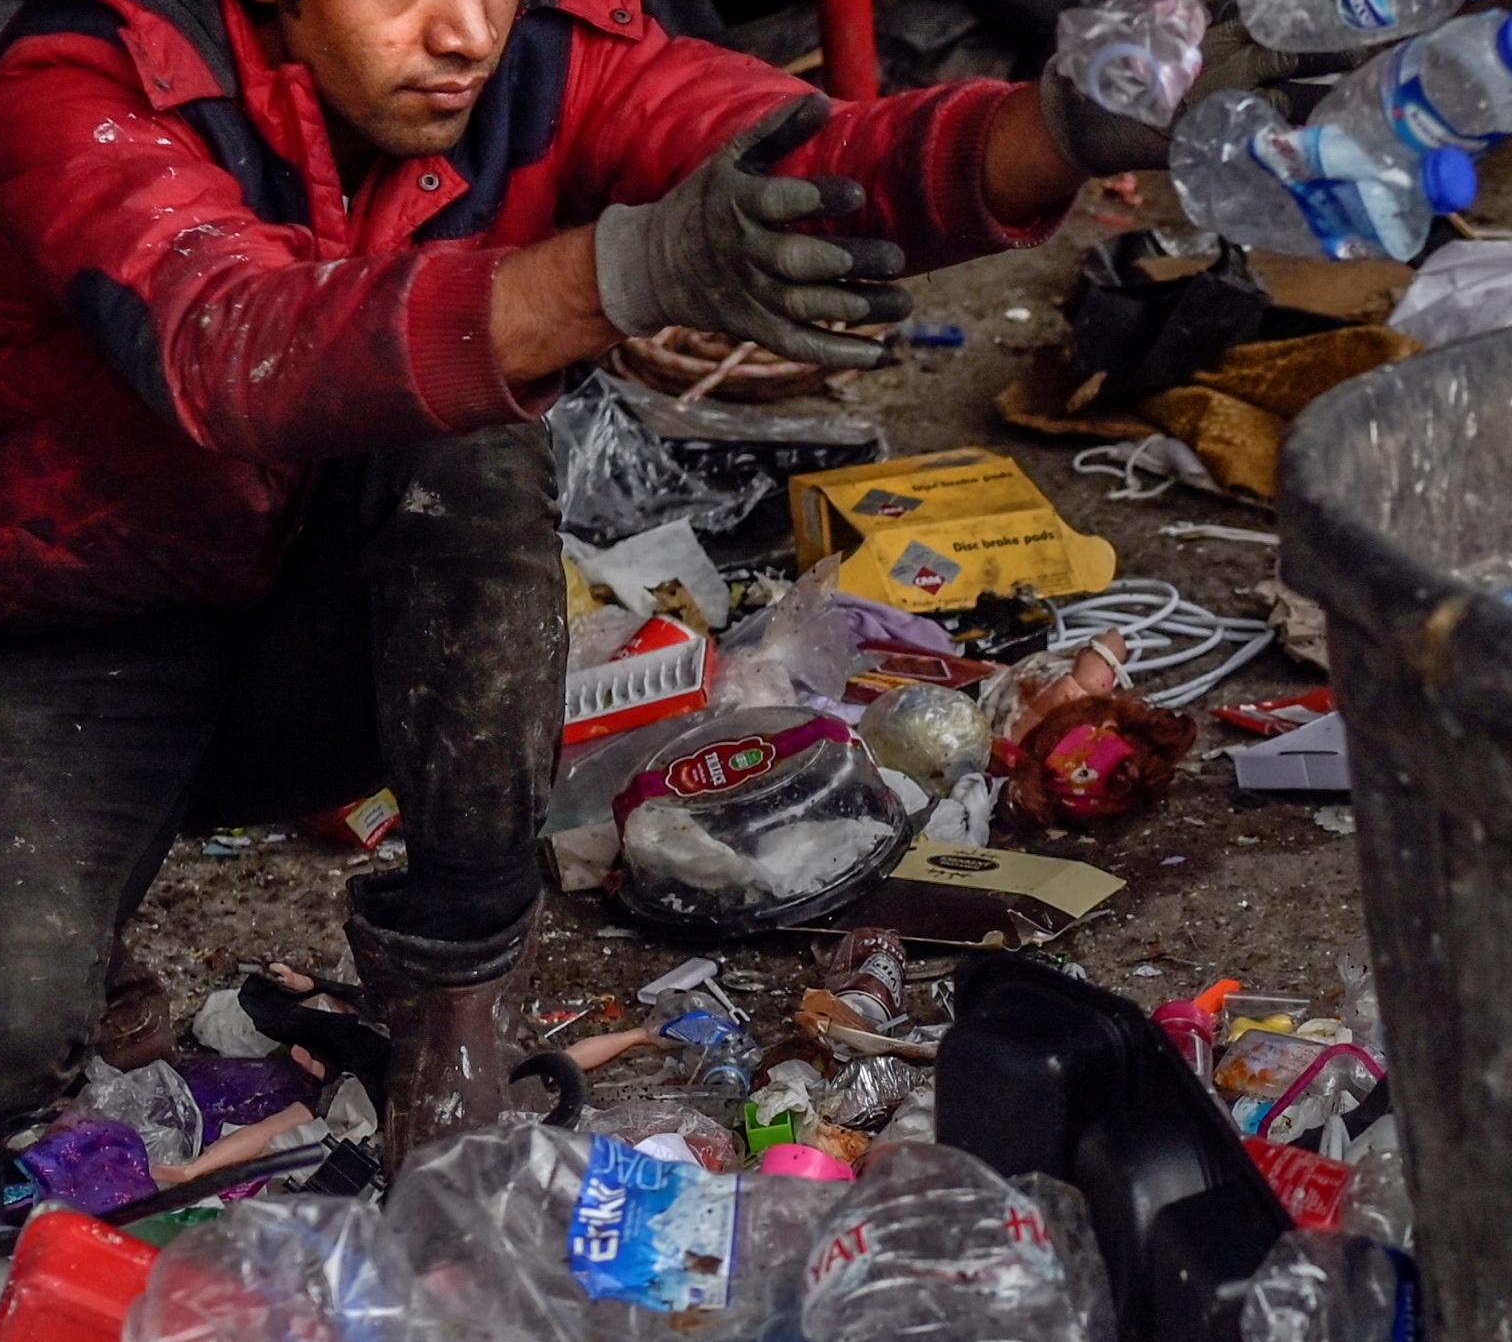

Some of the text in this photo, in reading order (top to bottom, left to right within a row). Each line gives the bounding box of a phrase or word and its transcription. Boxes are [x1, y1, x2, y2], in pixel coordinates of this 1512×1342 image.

[952, 529, 1056, 554] Disc brake pads
[573, 1176, 626, 1263] Erikli
